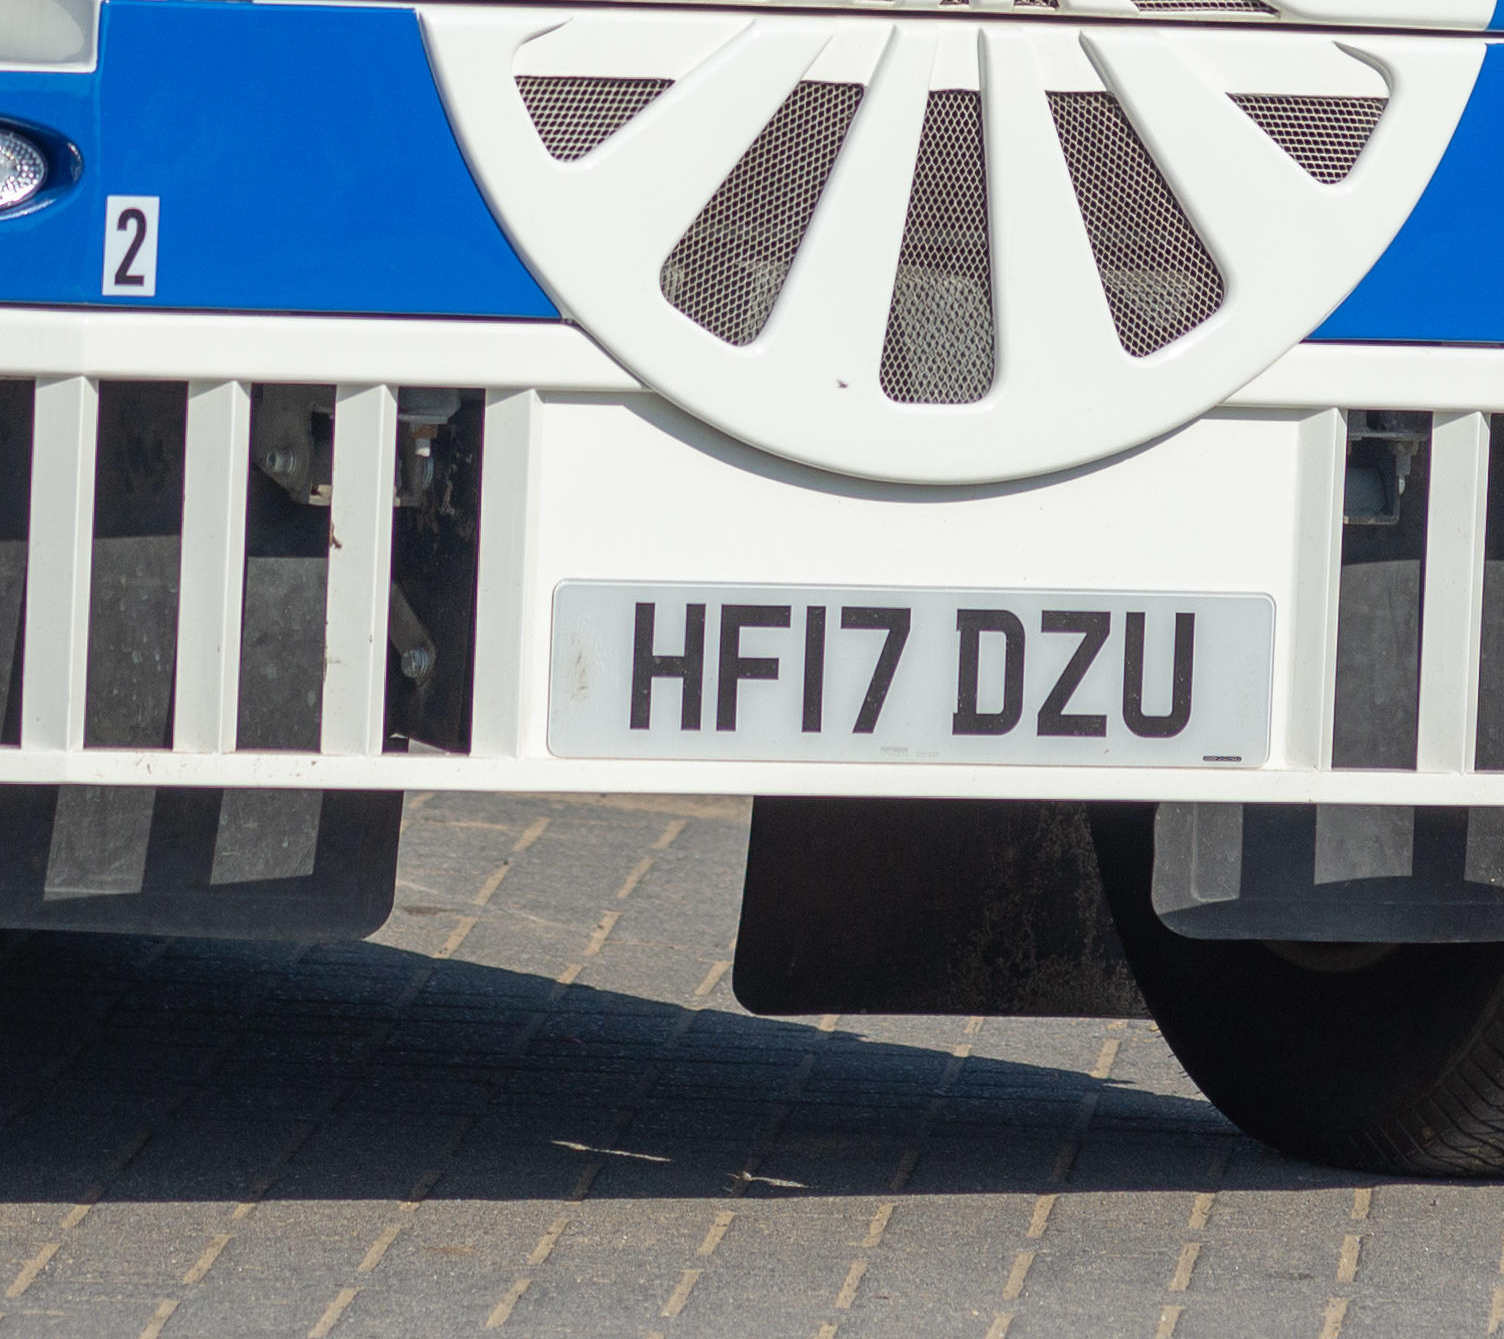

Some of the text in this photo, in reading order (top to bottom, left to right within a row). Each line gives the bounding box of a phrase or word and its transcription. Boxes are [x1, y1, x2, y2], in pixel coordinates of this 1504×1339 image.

[114, 207, 148, 286] 2
[629, 601, 1196, 739] HF17 DZU
